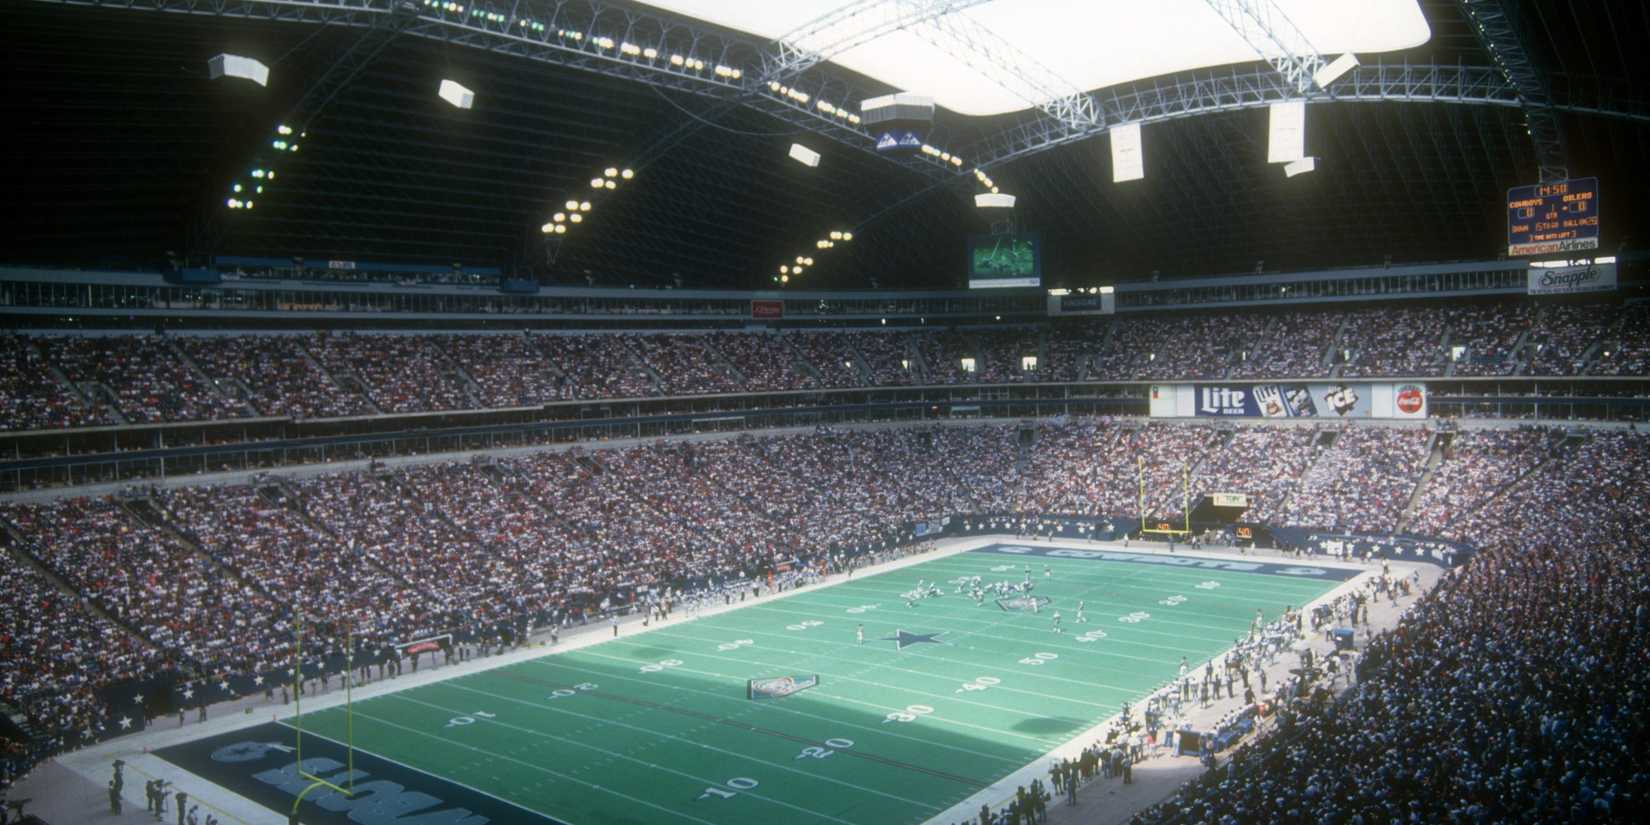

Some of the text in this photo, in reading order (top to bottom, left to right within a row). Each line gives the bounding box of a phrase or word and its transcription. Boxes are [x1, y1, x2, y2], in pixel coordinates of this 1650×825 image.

[1509, 198, 1543, 209] COWBOYS
[1562, 192, 1593, 202] OILERS
[1541, 268, 1598, 288] Snapple
[1201, 387, 1245, 413] Lite
[1237, 527, 1251, 538] 40
[1046, 550, 1265, 571] COWBOYS
[1018, 652, 1058, 665] 50
[551, 682, 599, 697] 20
[961, 676, 1001, 691] 40
[449, 710, 496, 725] 10
[886, 704, 934, 722] 30
[801, 738, 854, 759] 20
[705, 777, 759, 799] 10
